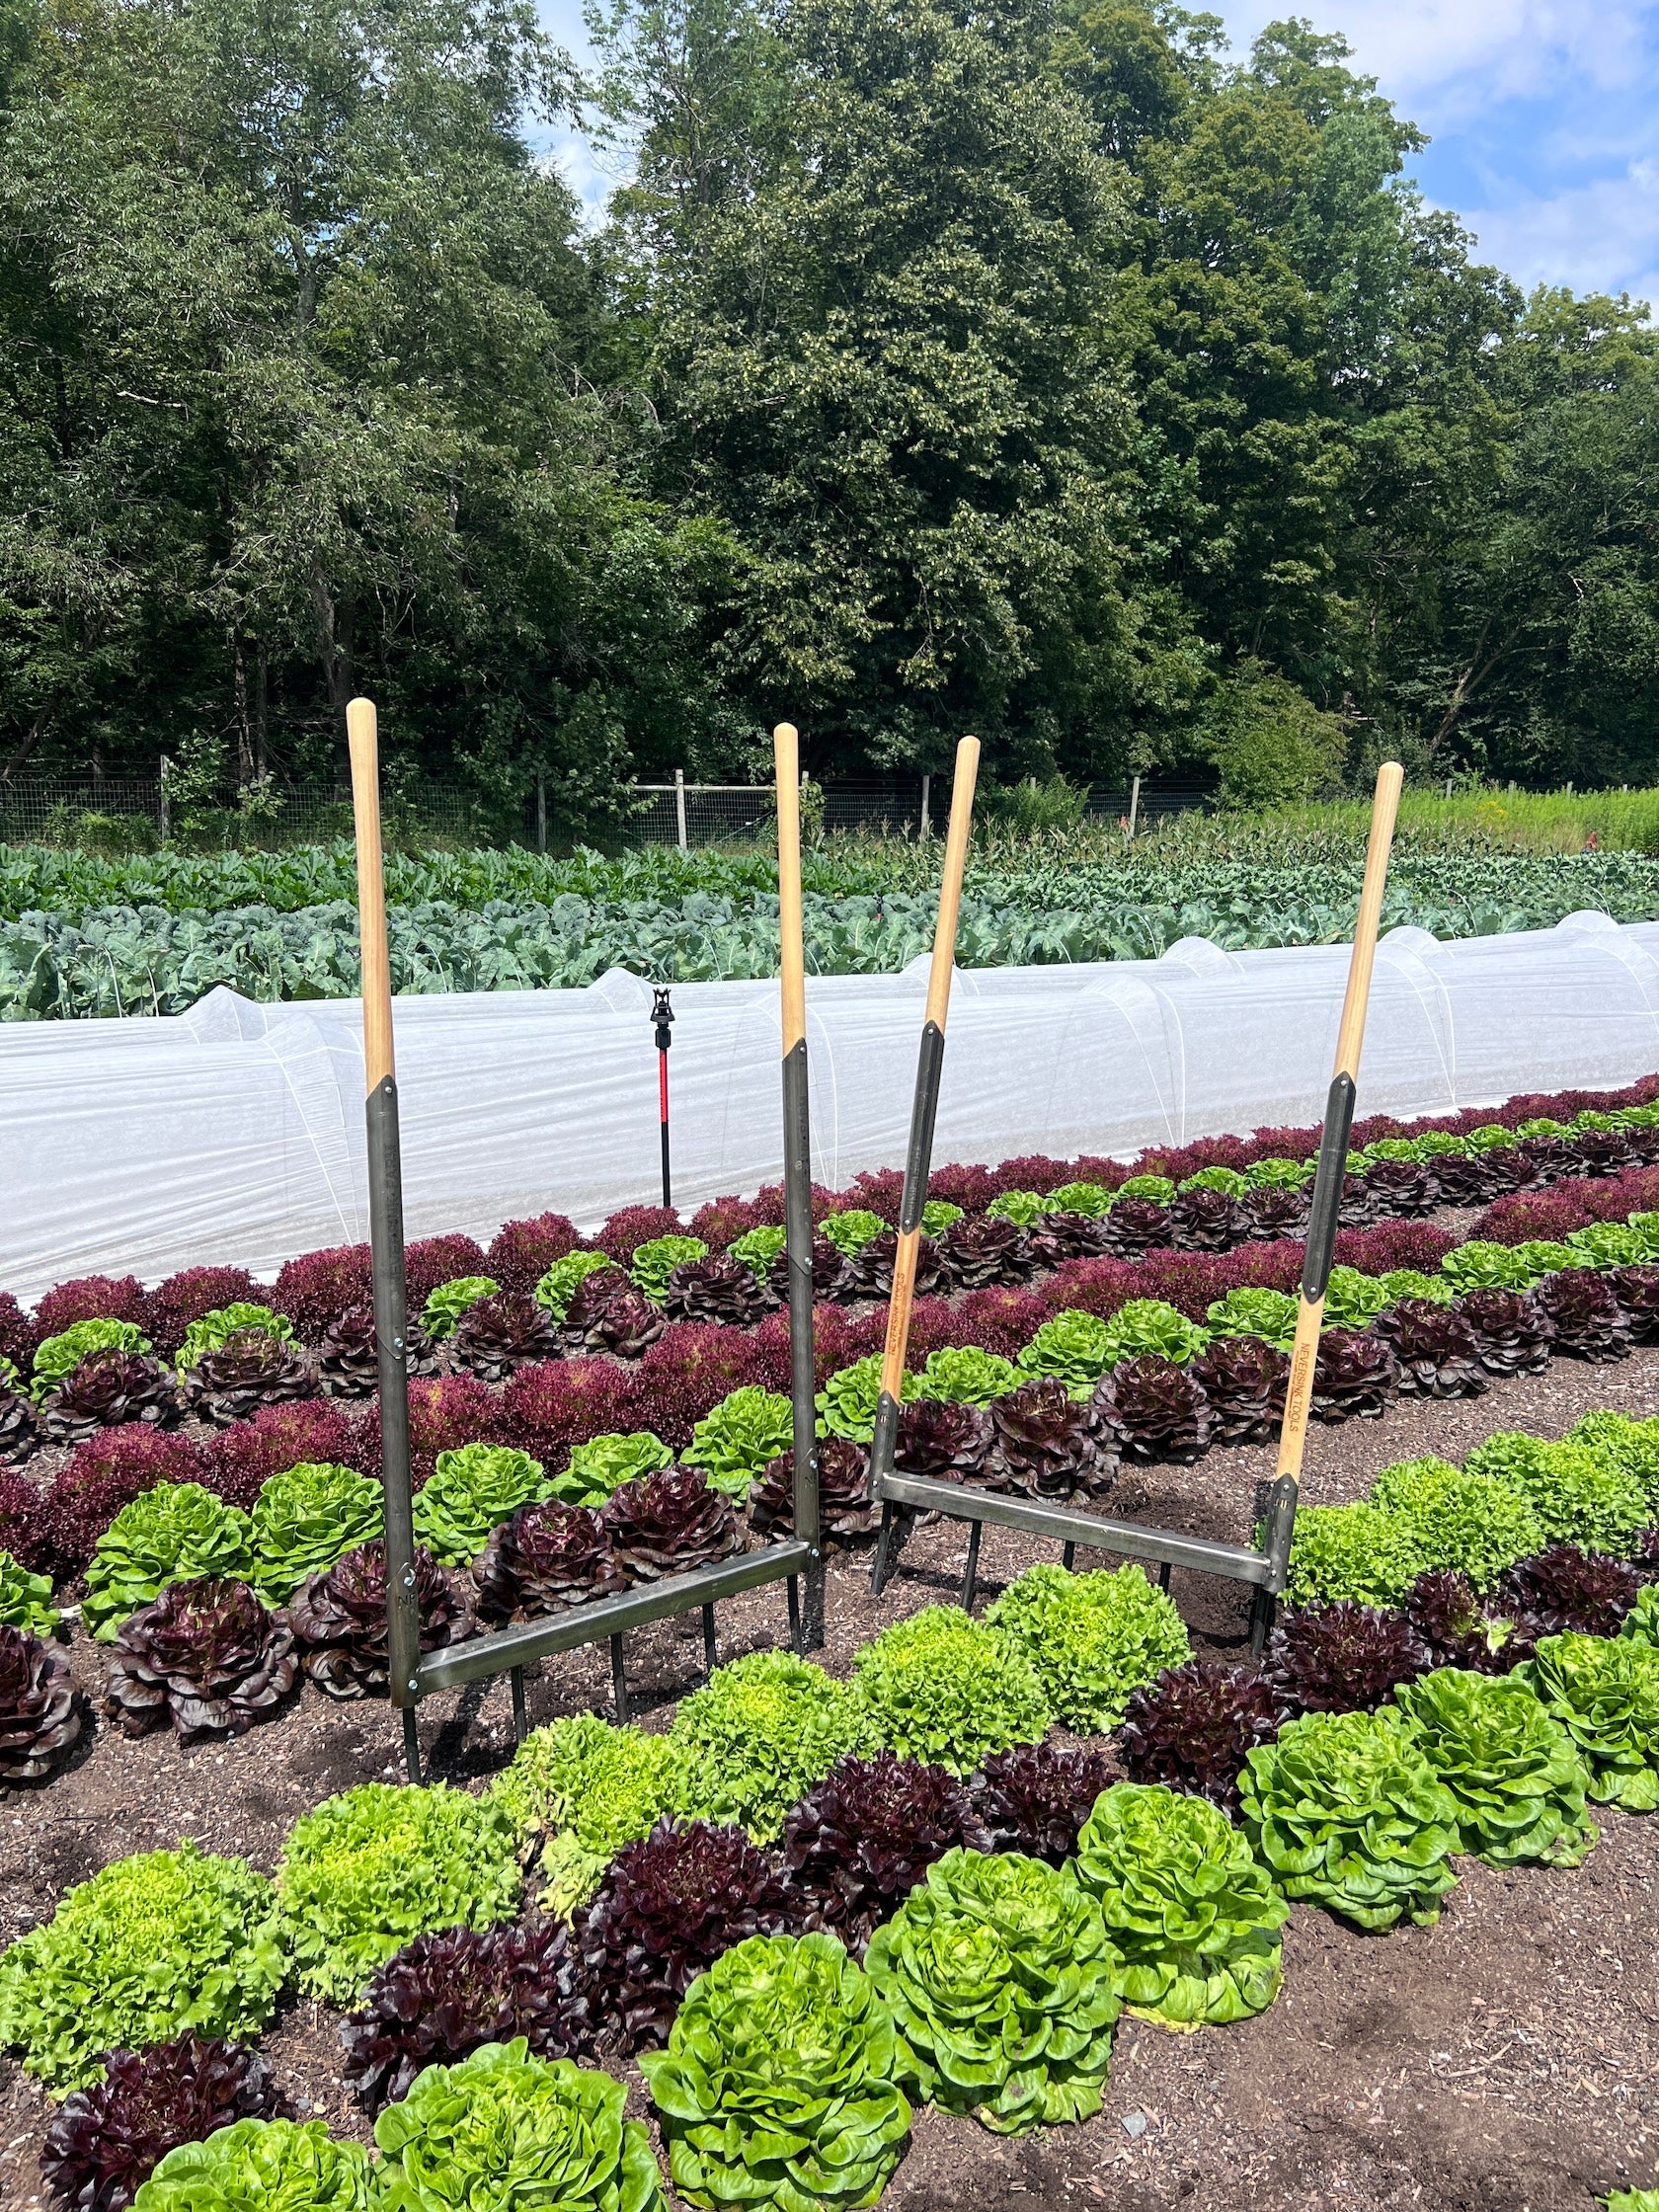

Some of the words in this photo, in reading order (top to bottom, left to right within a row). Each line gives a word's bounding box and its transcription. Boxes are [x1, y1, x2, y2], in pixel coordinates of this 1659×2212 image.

[888, 1305, 900, 1356] NEVERSINK
[895, 1272, 906, 1302] TOOLS
[1294, 1343, 1310, 1398] NEVERSINK
[1290, 1400, 1303, 1432] TOOLS
